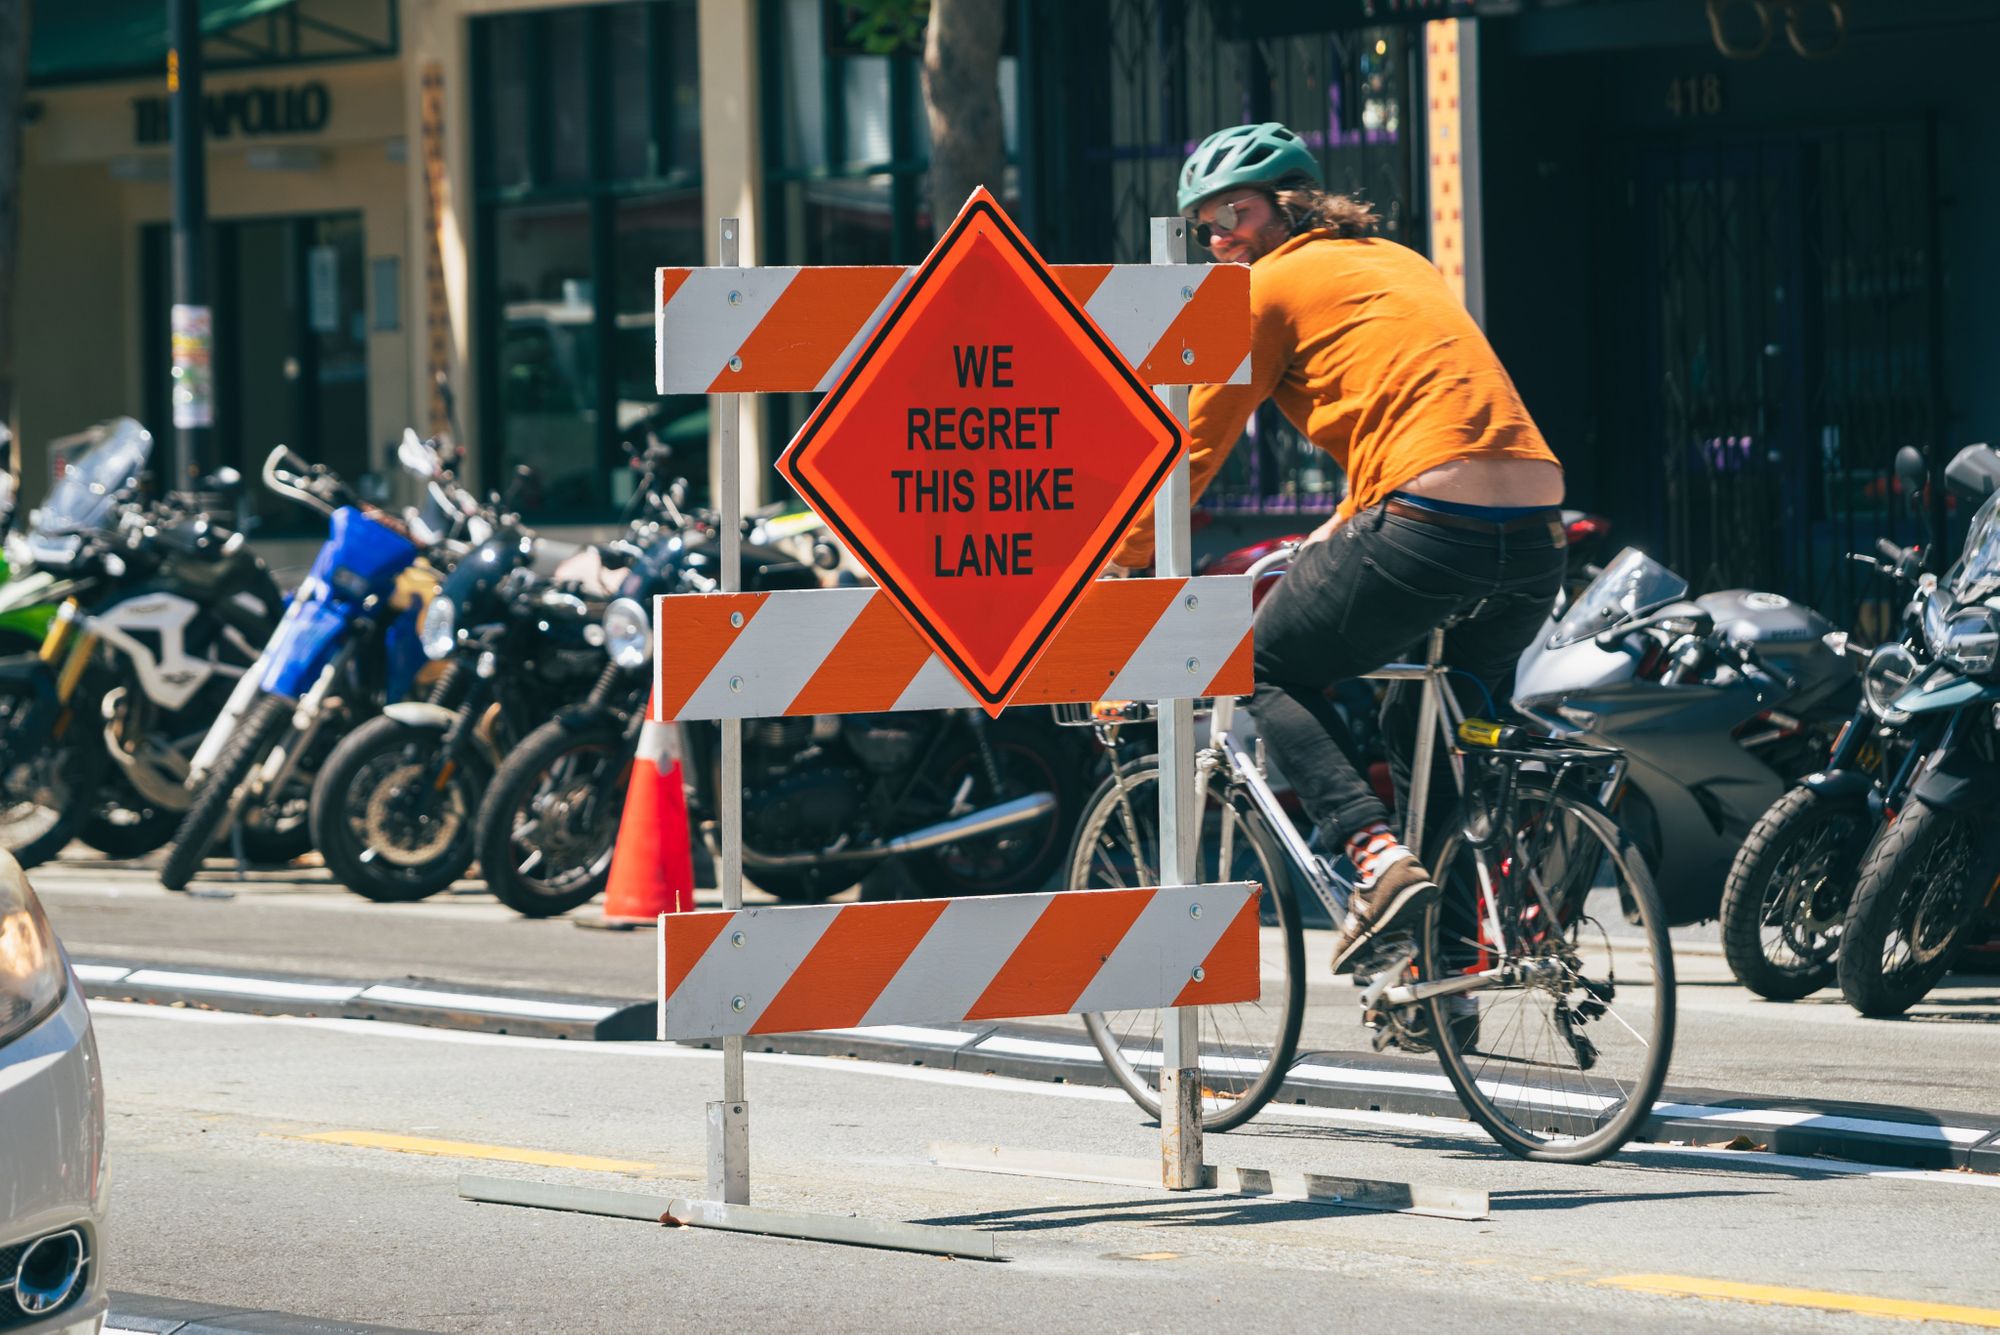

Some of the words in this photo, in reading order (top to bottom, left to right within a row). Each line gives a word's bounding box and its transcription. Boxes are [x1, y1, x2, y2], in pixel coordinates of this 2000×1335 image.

[1664, 73, 1720, 117] 418
[131, 95, 172, 145] TH
[953, 345, 1014, 388] WE
[907, 407, 1060, 450] REGRET
[891, 469, 975, 512] THIS
[989, 468, 1074, 512] BIKE
[935, 533, 1033, 577] LANE
